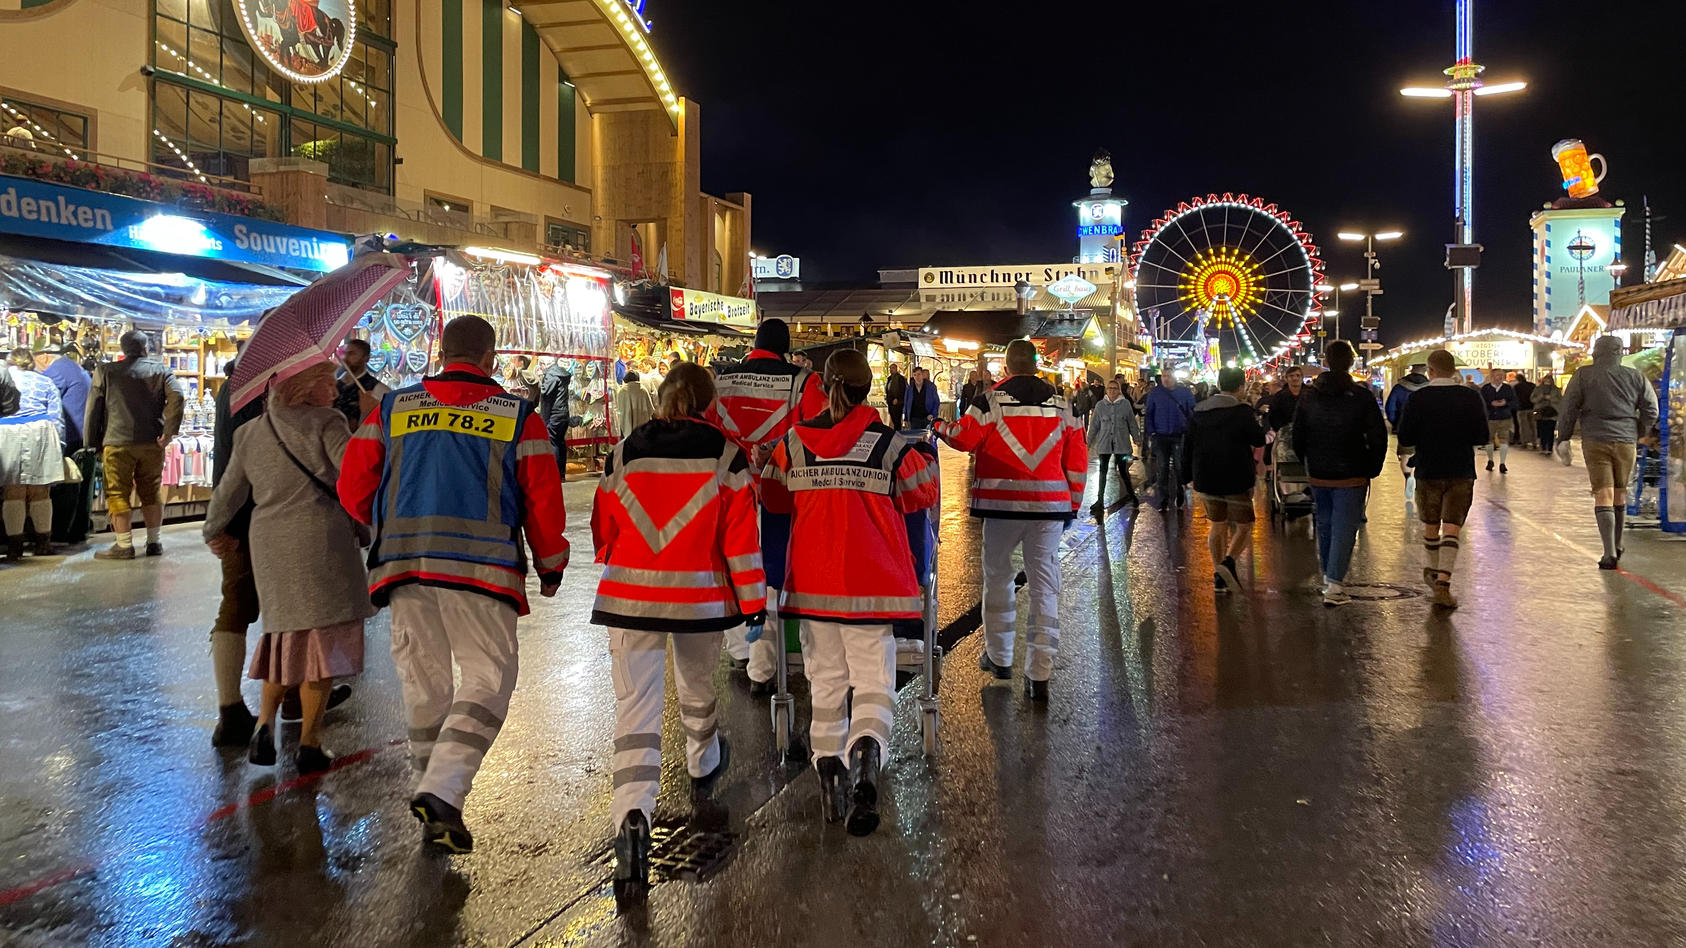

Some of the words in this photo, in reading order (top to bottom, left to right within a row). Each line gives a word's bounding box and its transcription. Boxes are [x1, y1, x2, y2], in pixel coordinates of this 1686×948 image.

[0, 187, 114, 230] denken
[234, 223, 337, 261] Souvenir
[940, 269, 1032, 284] Münchner
[689, 298, 724, 318] Bayerische
[727, 302, 750, 318] Brotzeit
[740, 374, 770, 382] AMBULANZ
[399, 392, 431, 403] AICHER
[486, 397, 516, 408] UNION
[406, 412, 440, 429] RM
[447, 412, 496, 434] 78.2
[791, 468, 819, 479] AICHER
[820, 467, 861, 476] AMBULANZ
[862, 470, 889, 481] UNION
